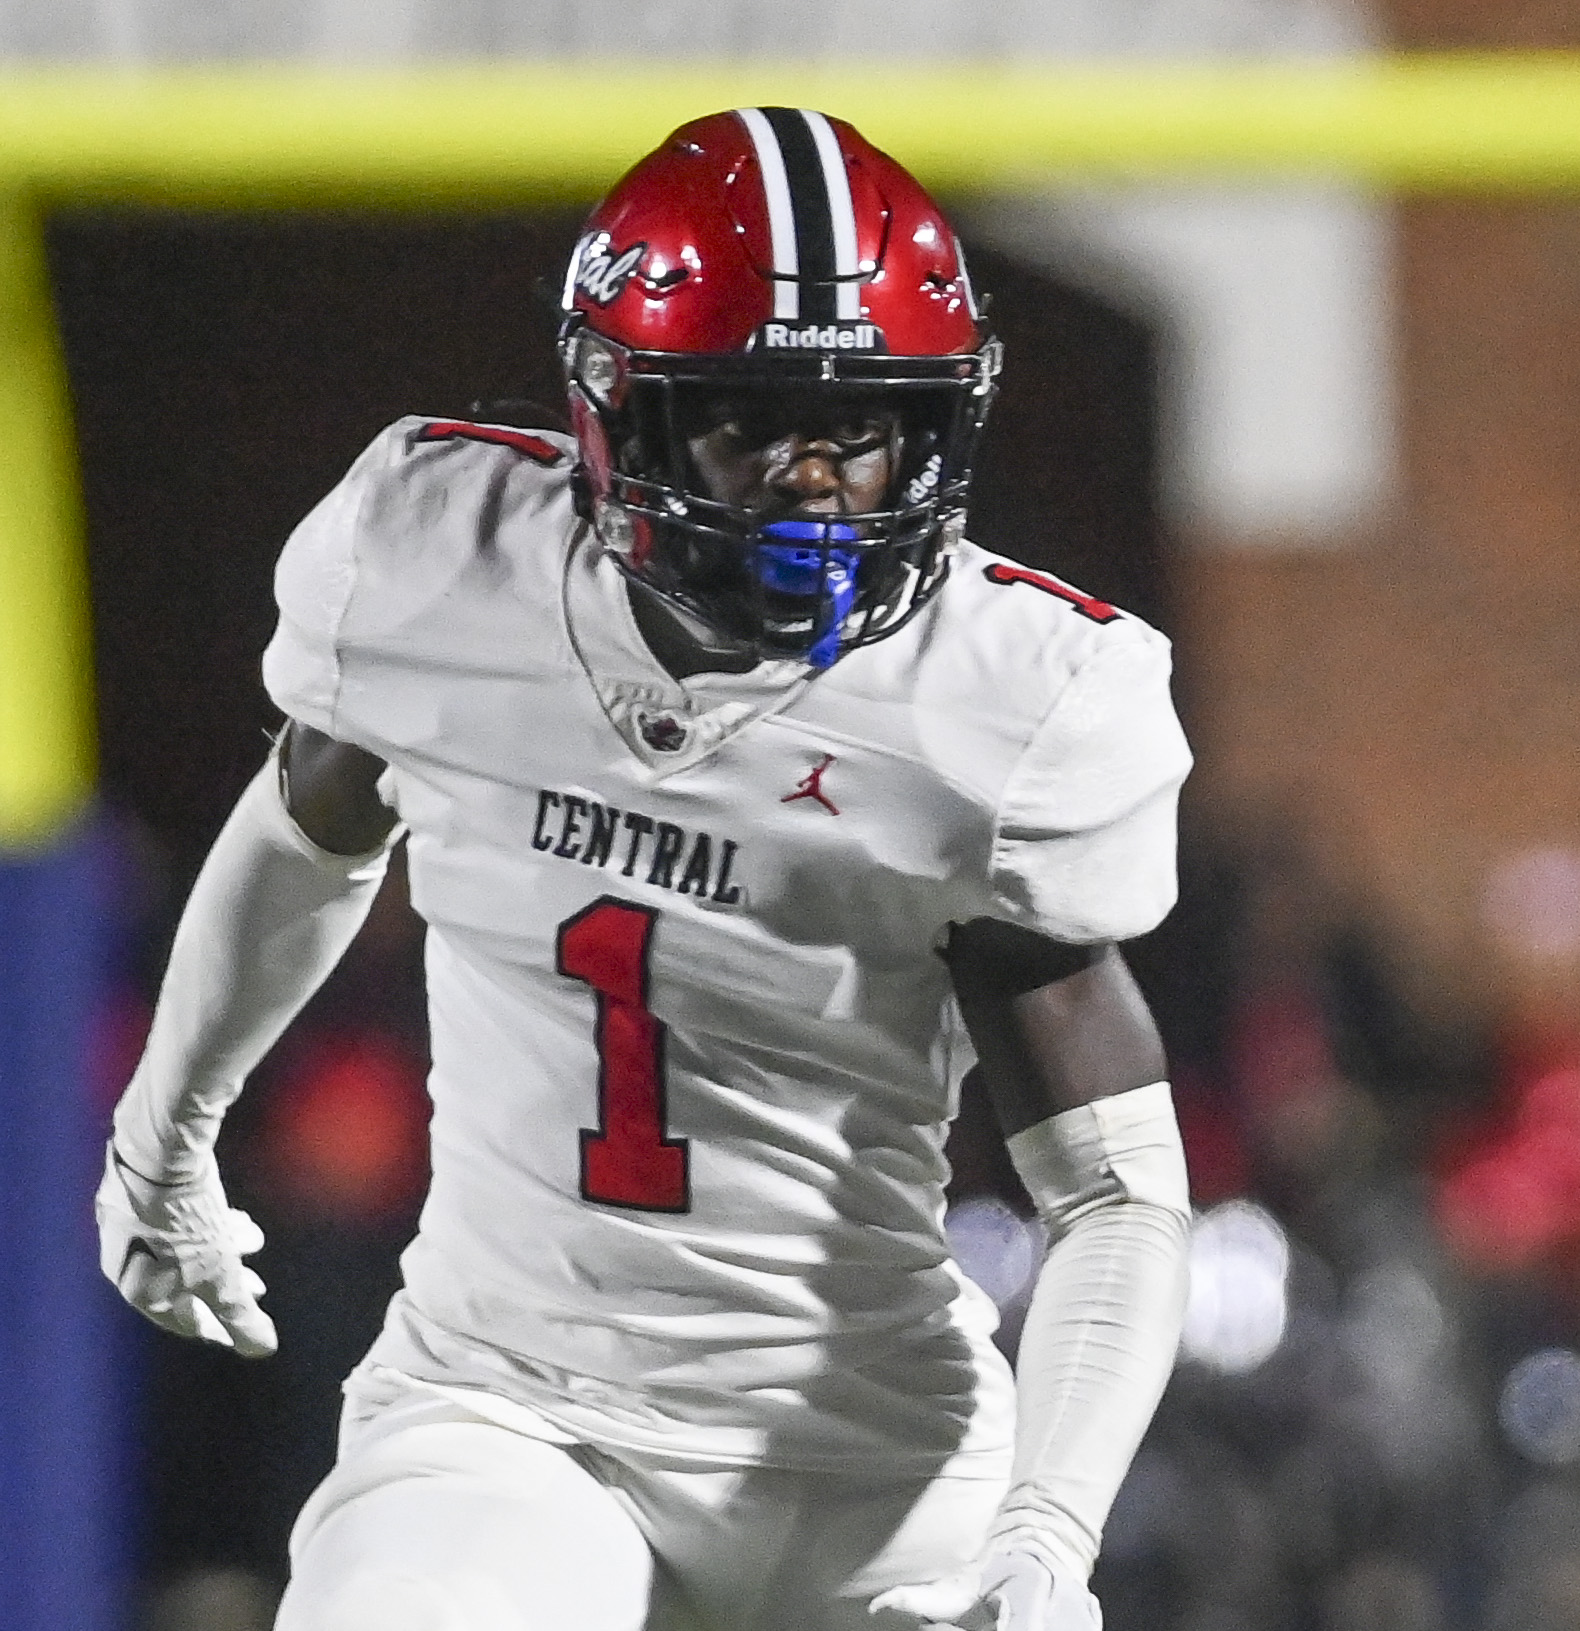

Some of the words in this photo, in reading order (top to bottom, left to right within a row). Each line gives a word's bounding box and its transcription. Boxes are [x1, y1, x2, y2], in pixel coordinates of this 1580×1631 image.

[764, 323, 875, 349] Riddell
[531, 789, 741, 905] CENTRAL
[555, 894, 692, 1213] 1
